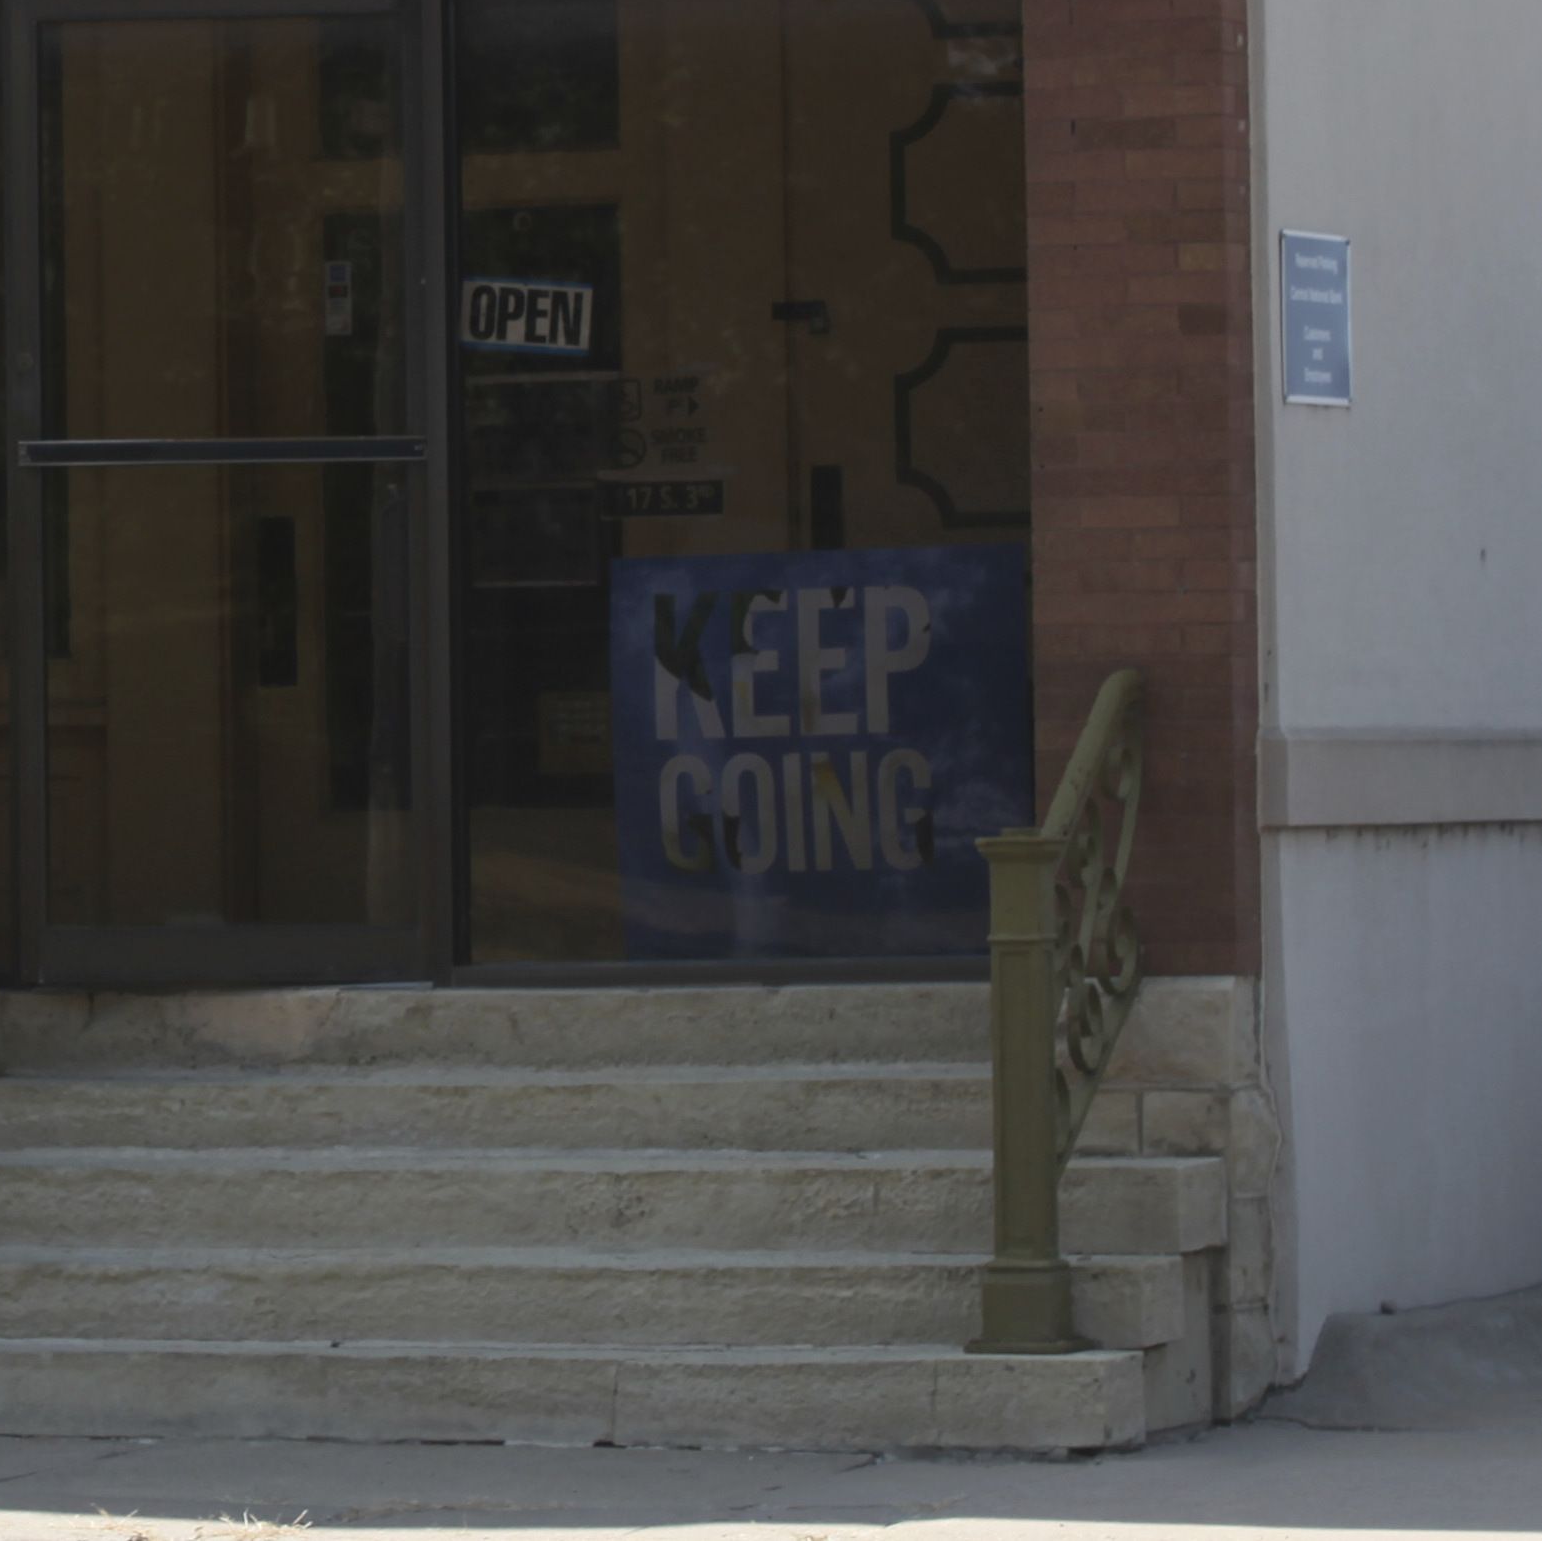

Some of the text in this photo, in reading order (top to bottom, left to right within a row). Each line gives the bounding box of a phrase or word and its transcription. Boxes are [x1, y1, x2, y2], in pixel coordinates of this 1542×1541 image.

[468, 283, 584, 347] OPEN
[653, 585, 933, 742] KEEP
[658, 747, 934, 874] GOING
